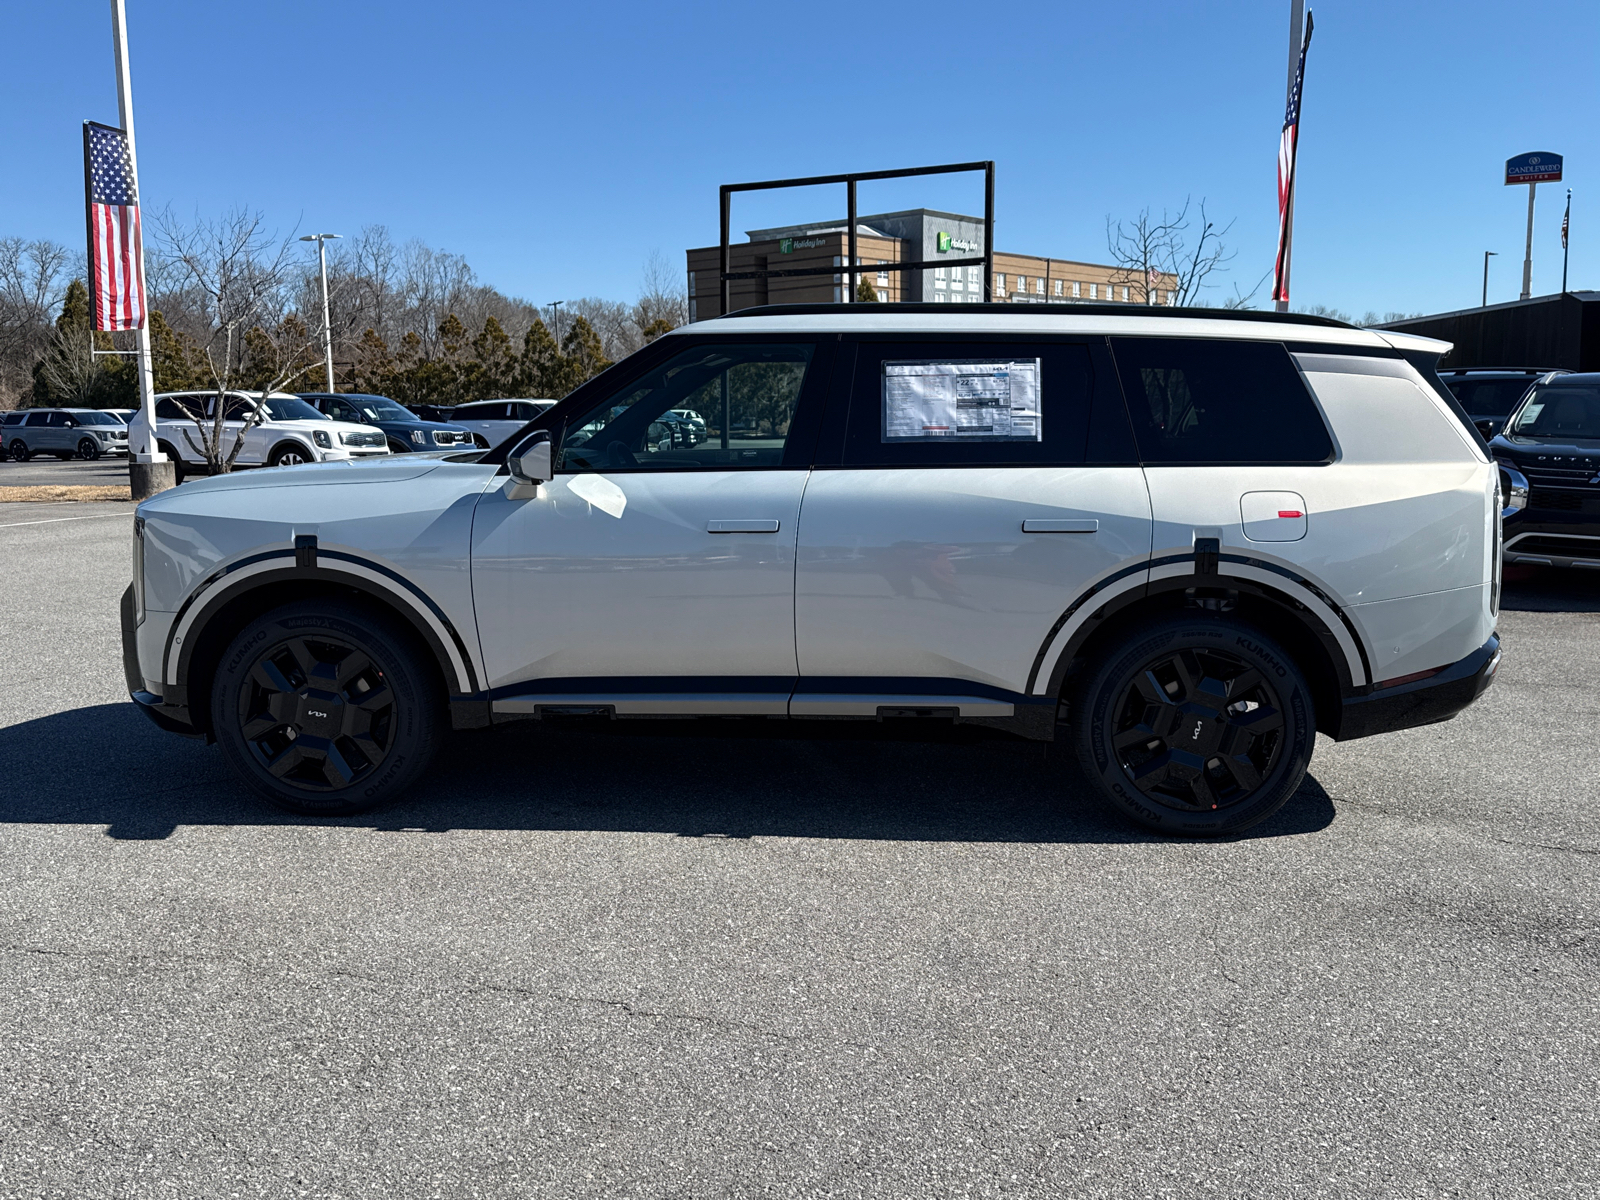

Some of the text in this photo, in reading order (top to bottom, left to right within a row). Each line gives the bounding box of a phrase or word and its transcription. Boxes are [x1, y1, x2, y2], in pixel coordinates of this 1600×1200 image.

[1508, 164, 1561, 174] CANDLEWOOD
[793, 239, 816, 249] Holiday
[816, 238, 826, 246] Inn
[950, 238, 970, 252] Holiday
[970, 240, 978, 250] Inn
[227, 630, 267, 674] KUMHO
[1235, 636, 1288, 679] KUMHO
[364, 754, 406, 798] KUMHO
[1111, 782, 1163, 823] KUMHO
